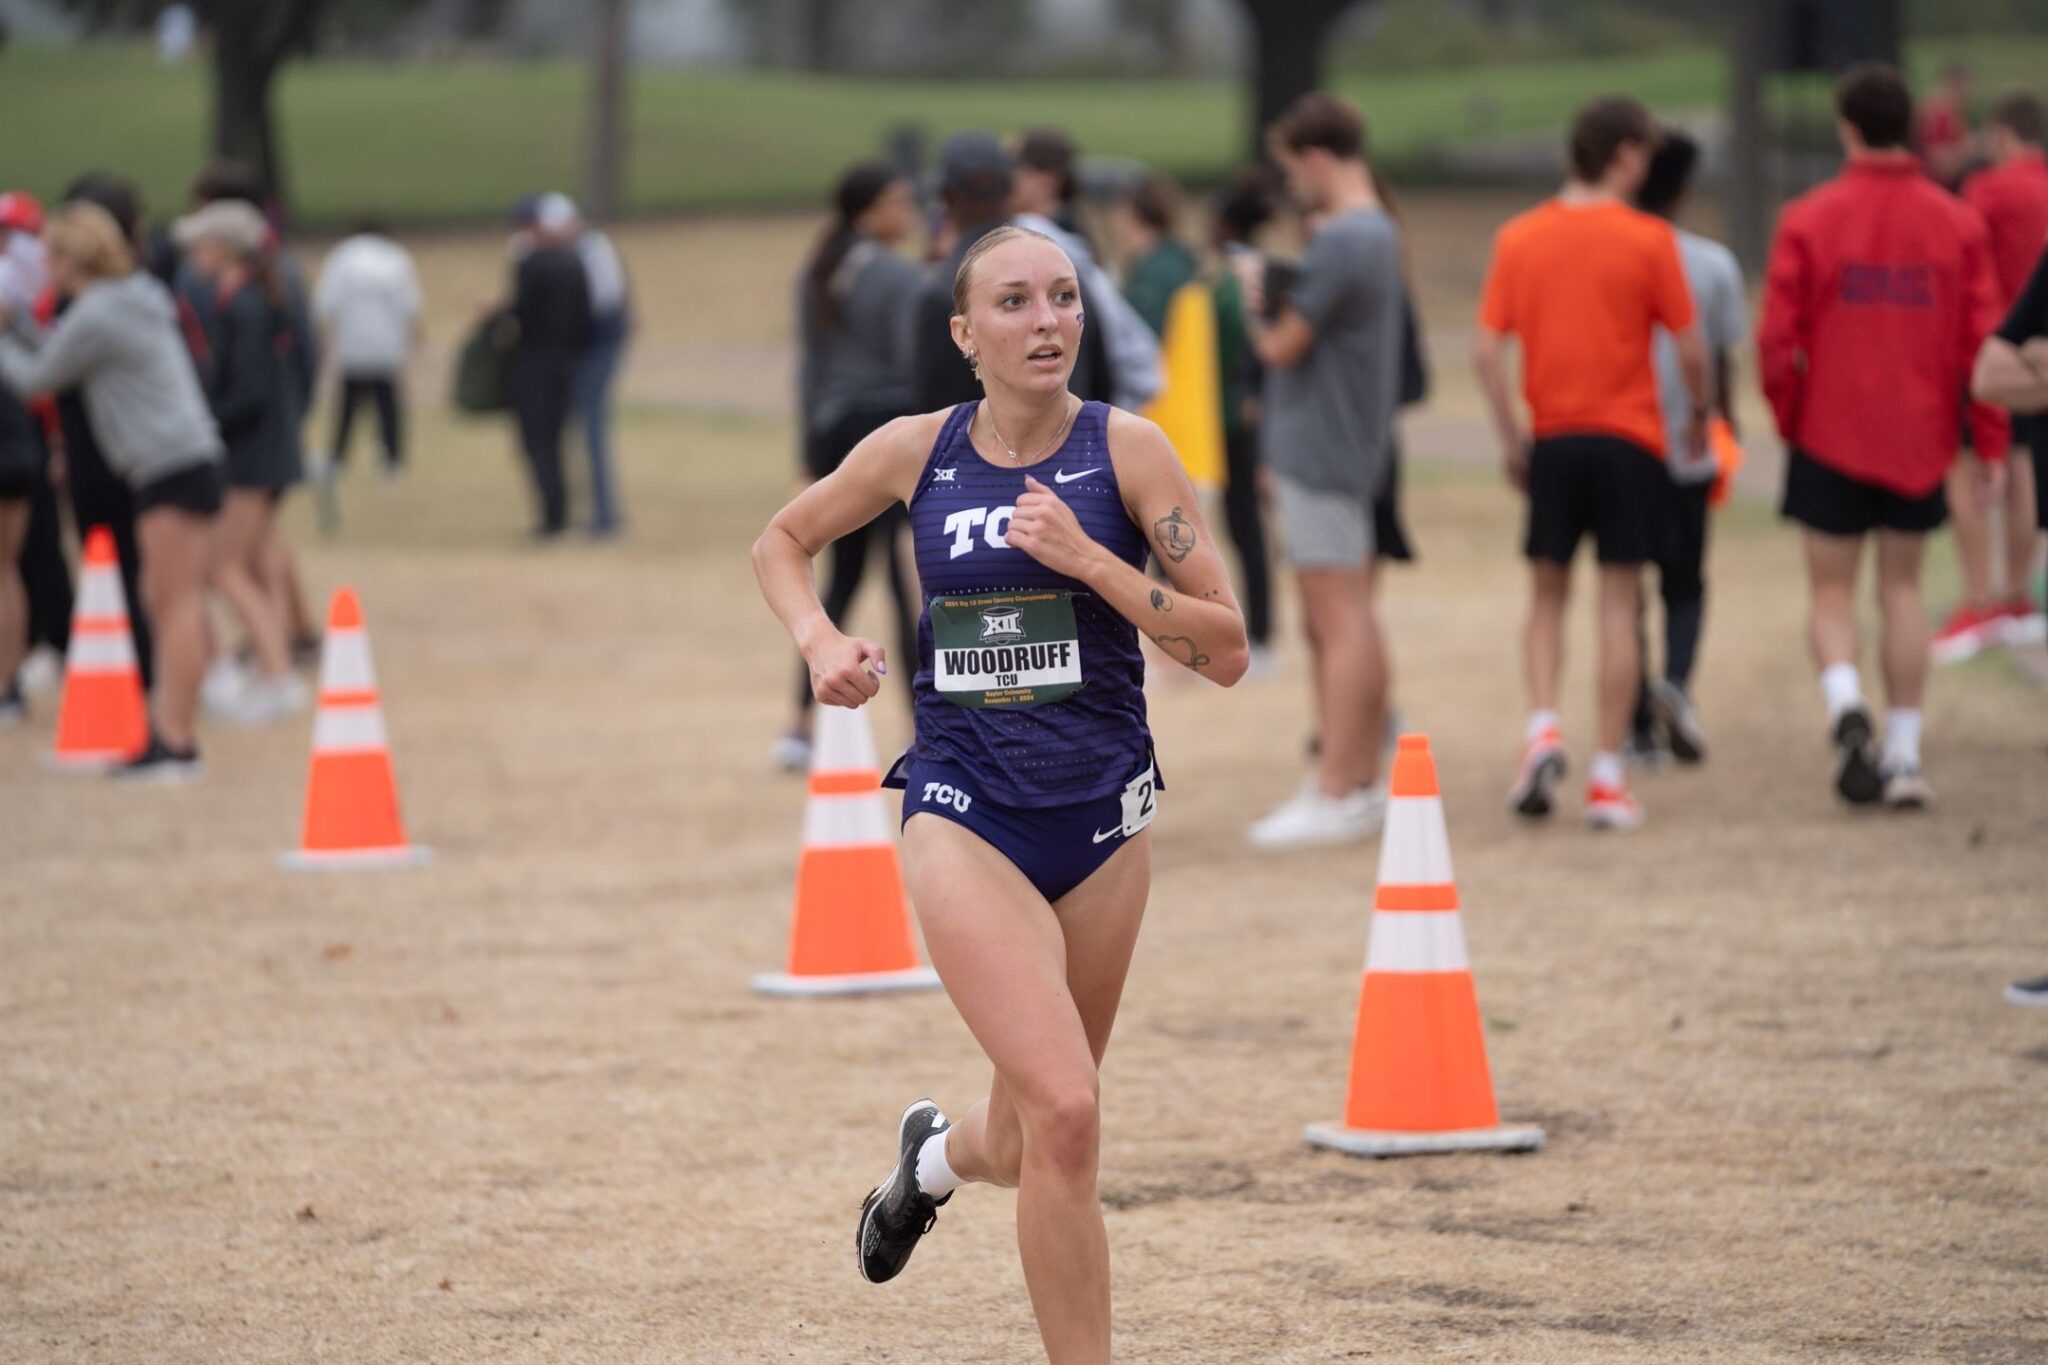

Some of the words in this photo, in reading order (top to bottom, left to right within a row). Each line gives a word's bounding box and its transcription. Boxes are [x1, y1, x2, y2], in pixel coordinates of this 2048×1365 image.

[943, 505, 1018, 560] TC
[944, 643, 1071, 675] WOODRUFF
[995, 674, 1018, 687] TCU
[921, 782, 972, 813] TCU
